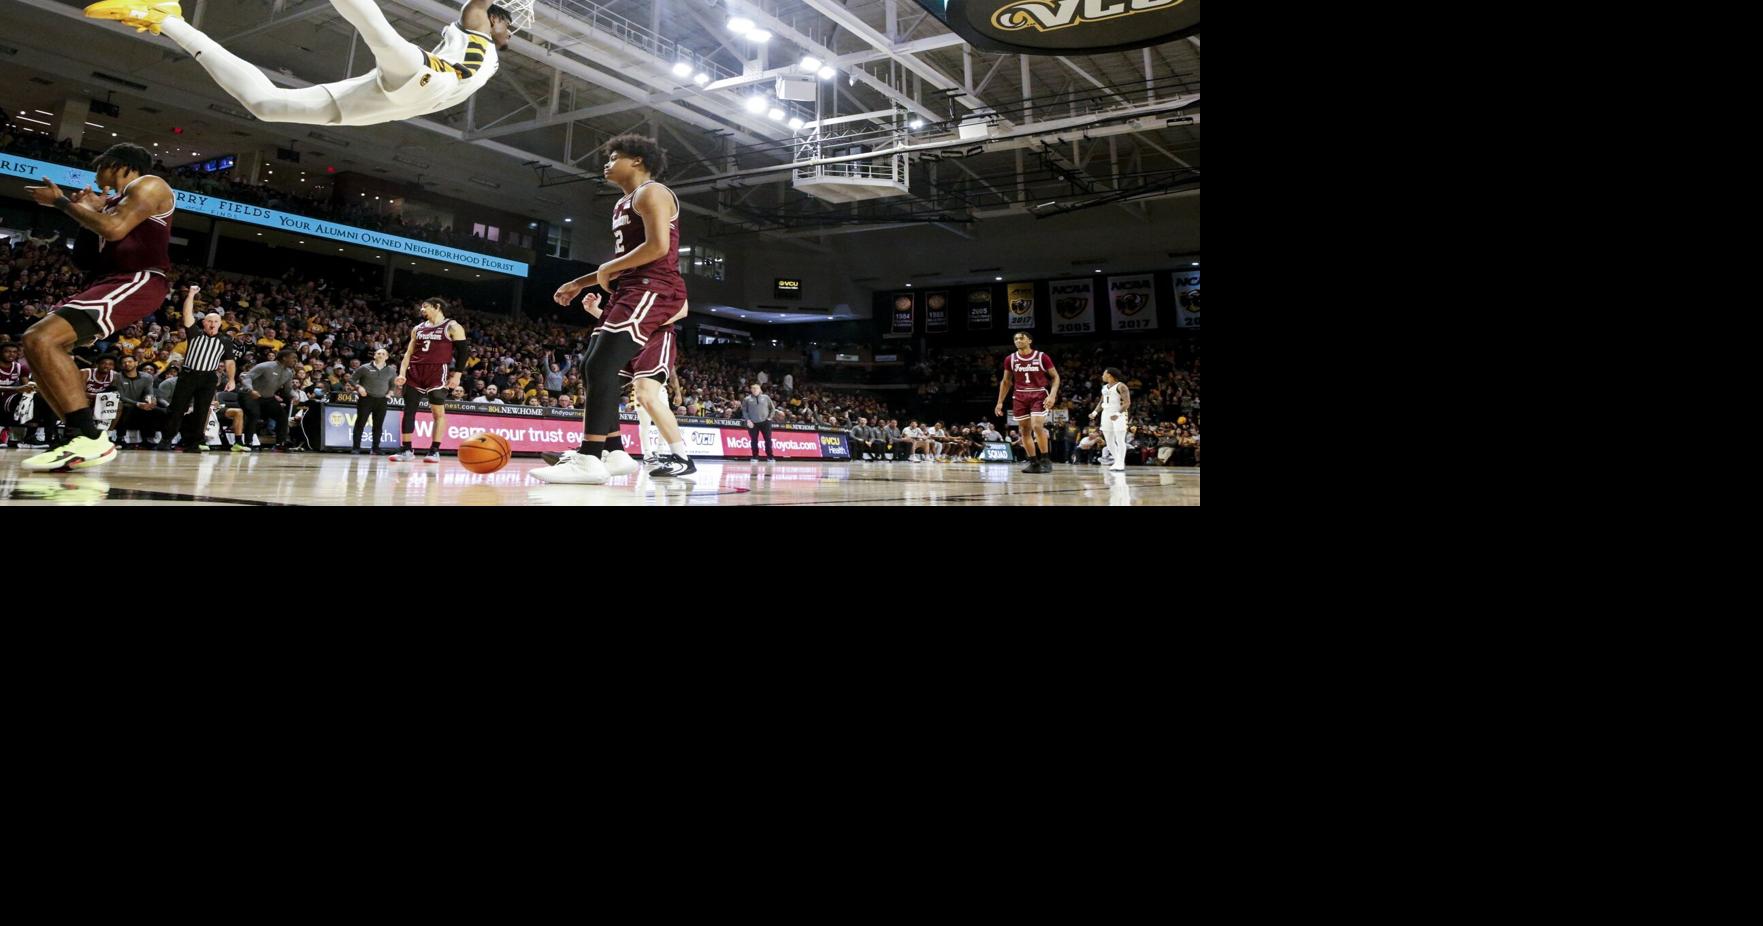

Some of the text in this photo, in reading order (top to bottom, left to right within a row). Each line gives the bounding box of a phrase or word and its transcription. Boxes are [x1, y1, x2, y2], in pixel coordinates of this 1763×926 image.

[173, 190, 208, 206] RRY
[219, 201, 271, 218] FIELDS
[421, 340, 431, 352] 3
[1024, 372, 1031, 383] 1
[528, 427, 564, 443] trust
[692, 431, 716, 446] VCU
